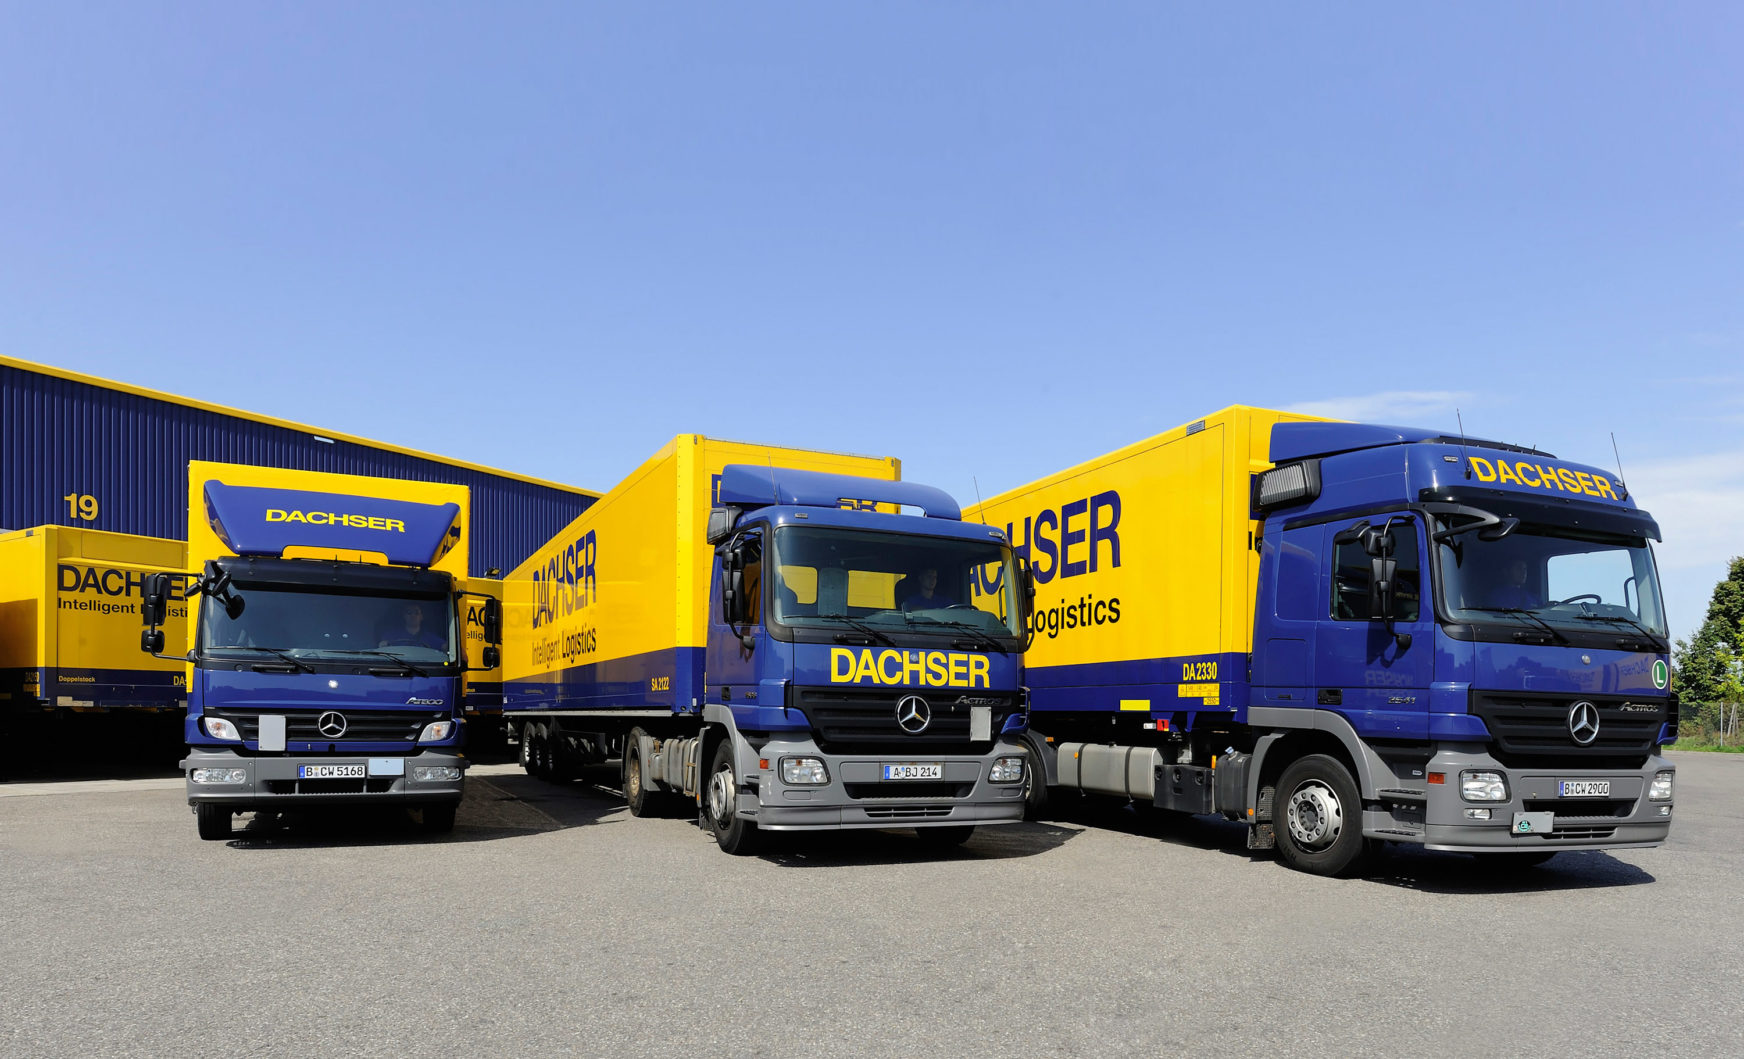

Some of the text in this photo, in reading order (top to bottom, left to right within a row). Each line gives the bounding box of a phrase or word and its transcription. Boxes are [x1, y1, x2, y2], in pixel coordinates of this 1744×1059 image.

[1468, 457, 1618, 501] DACHSER
[64, 493, 98, 521] 19
[266, 509, 405, 532] DACHSER
[533, 529, 596, 629] DACHSER
[58, 597, 135, 614] Intelligent
[1028, 594, 1121, 639] ogistics
[532, 622, 596, 669] Intelligent Logistics
[831, 648, 990, 688] DACHSER
[320, 766, 334, 776] CW
[337, 766, 364, 776] 5168
[920, 767, 937, 777] 214
[1588, 783, 1609, 794] 2900
